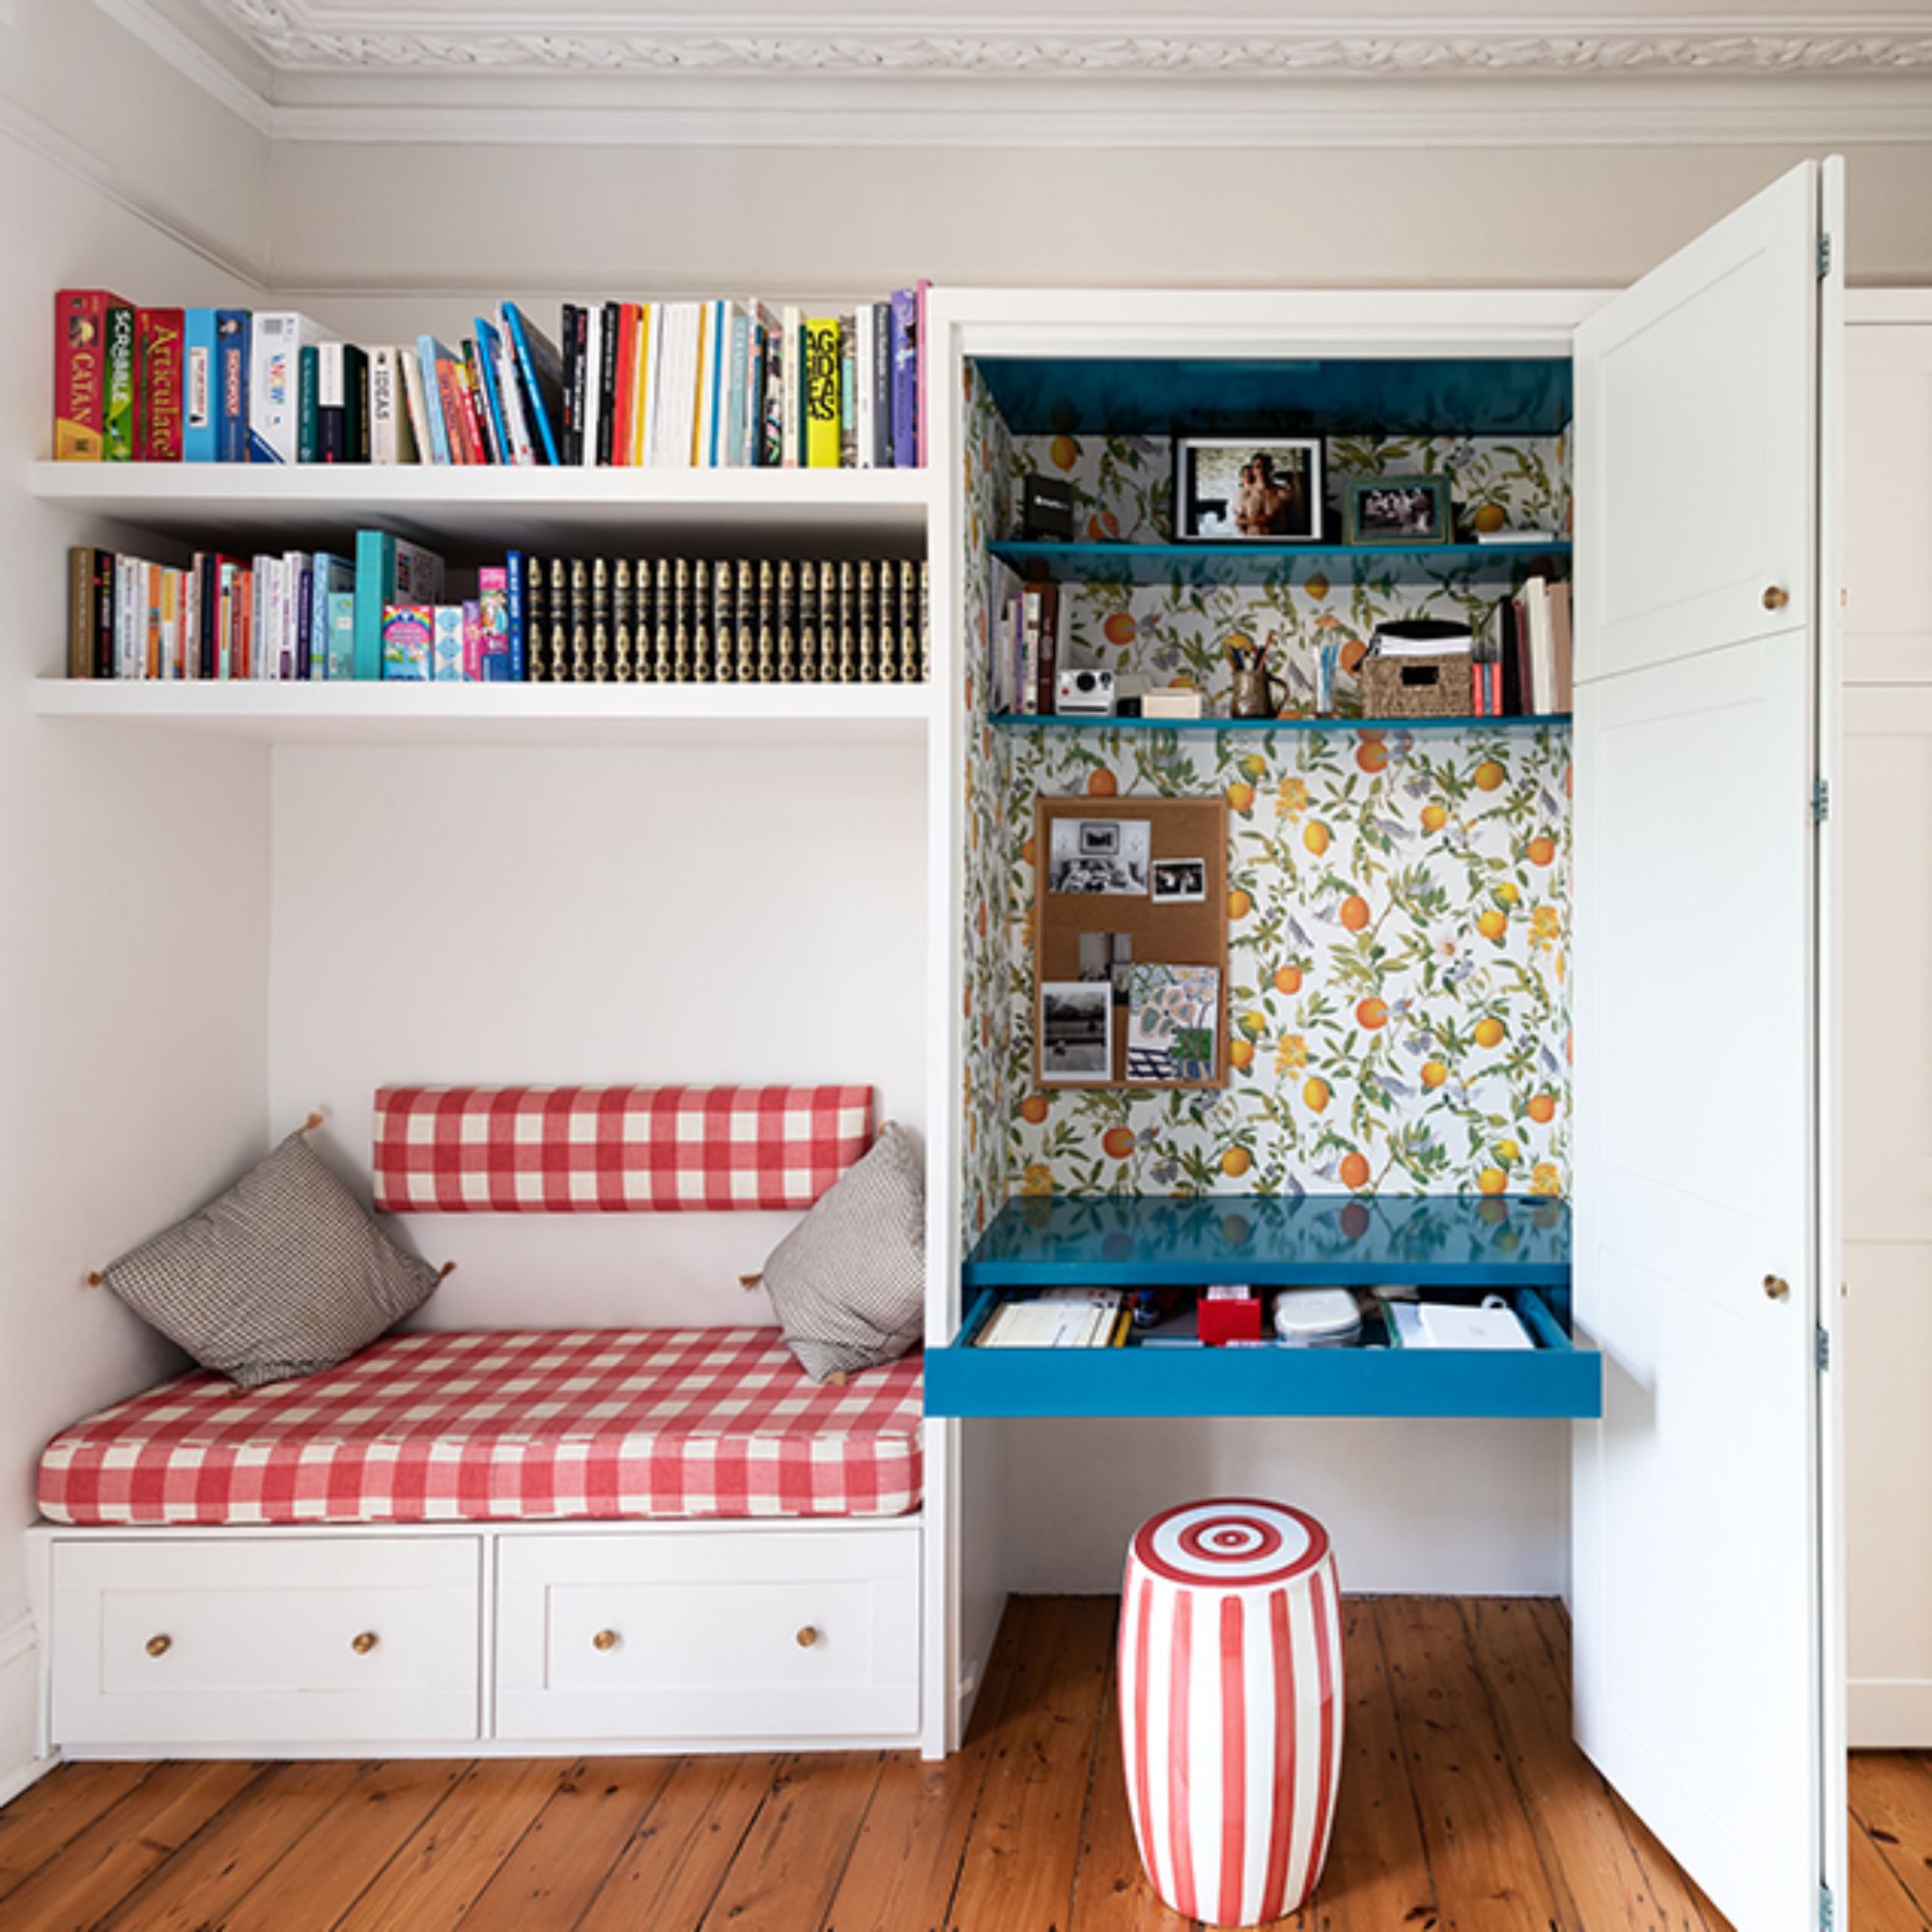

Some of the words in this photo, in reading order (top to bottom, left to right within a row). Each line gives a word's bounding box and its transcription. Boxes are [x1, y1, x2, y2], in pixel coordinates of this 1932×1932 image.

[71, 353, 95, 422] CATAN
[110, 309, 132, 403] SCRABBLE
[146, 324, 178, 458] Articulate!
[375, 370, 390, 420] IDEAS
